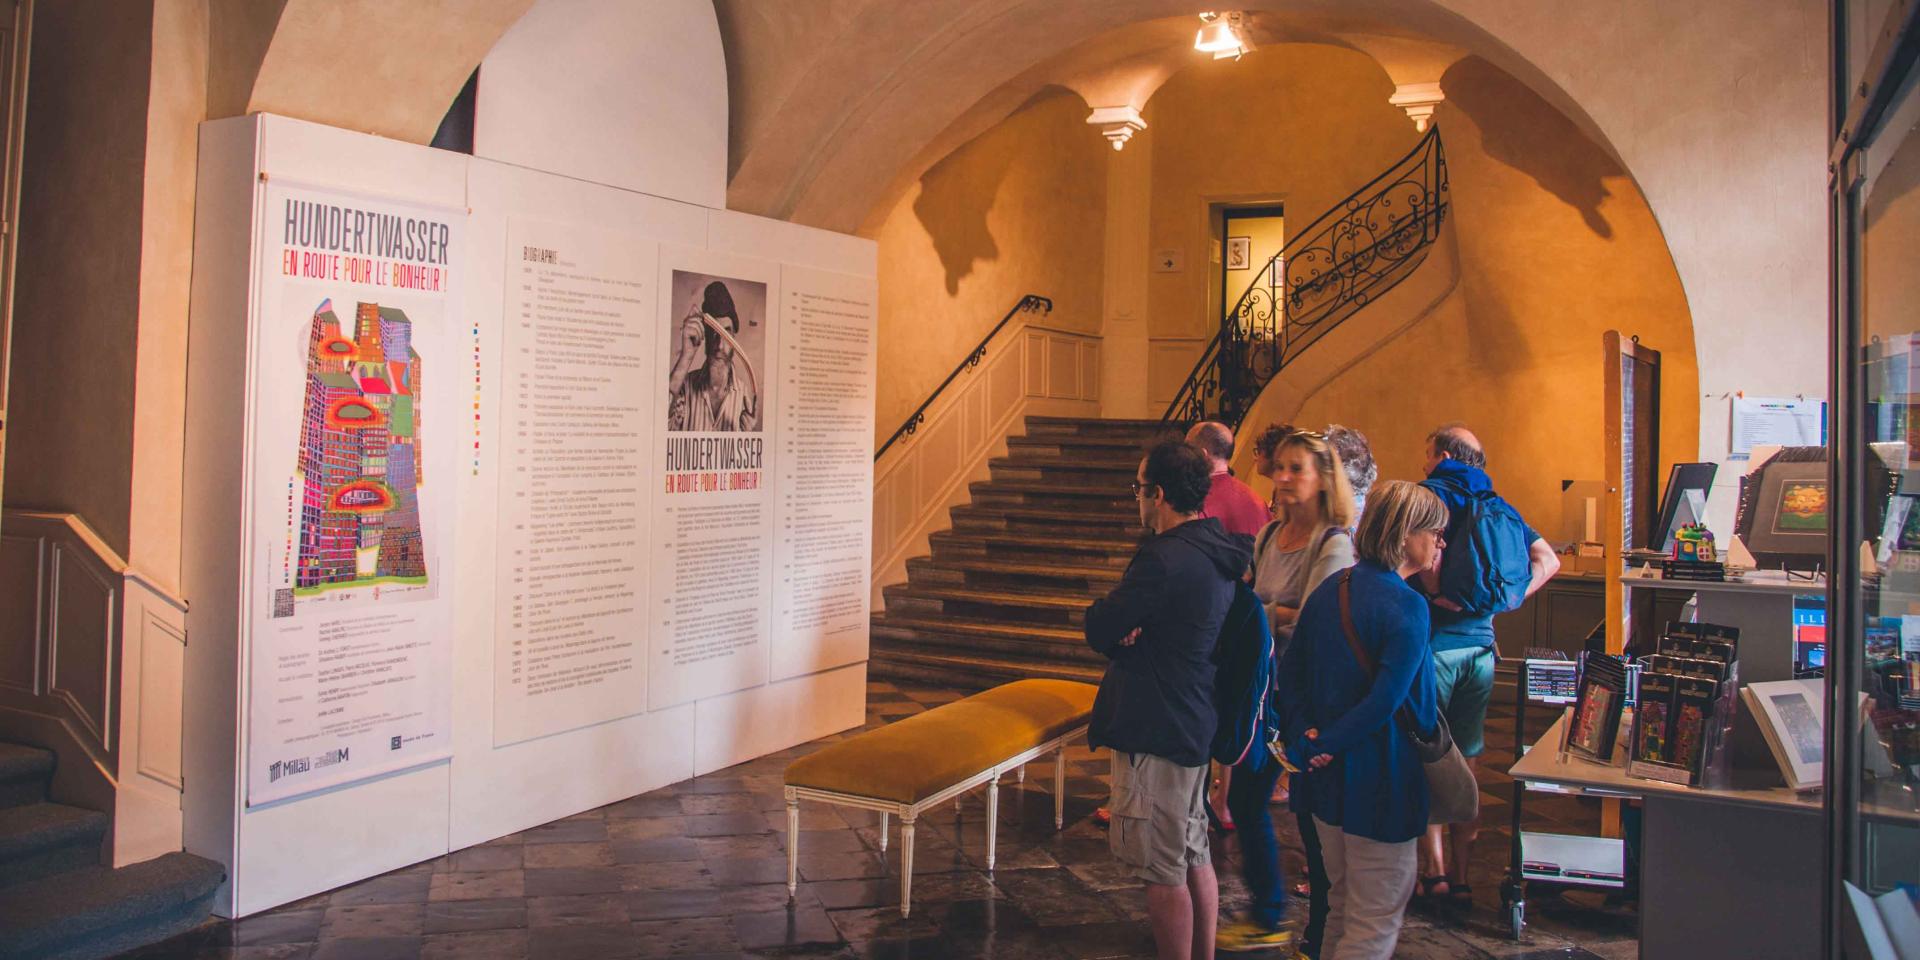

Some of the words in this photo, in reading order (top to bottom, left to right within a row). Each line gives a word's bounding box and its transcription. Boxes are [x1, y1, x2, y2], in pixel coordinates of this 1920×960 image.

[284, 198, 449, 266] HUNDERTWASSER
[523, 246, 558, 265] BIOGRAPHIE
[282, 249, 298, 277] EN
[303, 252, 340, 281] ROUTE
[344, 256, 371, 285] POUR
[376, 261, 388, 286] LE
[393, 263, 440, 292] BONHEUR
[666, 437, 763, 471] HUNDERTWASSER
[665, 474, 675, 494] EN
[677, 473, 698, 493] ROUTE
[700, 472, 718, 492] POUR
[719, 472, 728, 491] LE
[729, 471, 758, 491] BONHEUR
[283, 756, 310, 777] Millau
